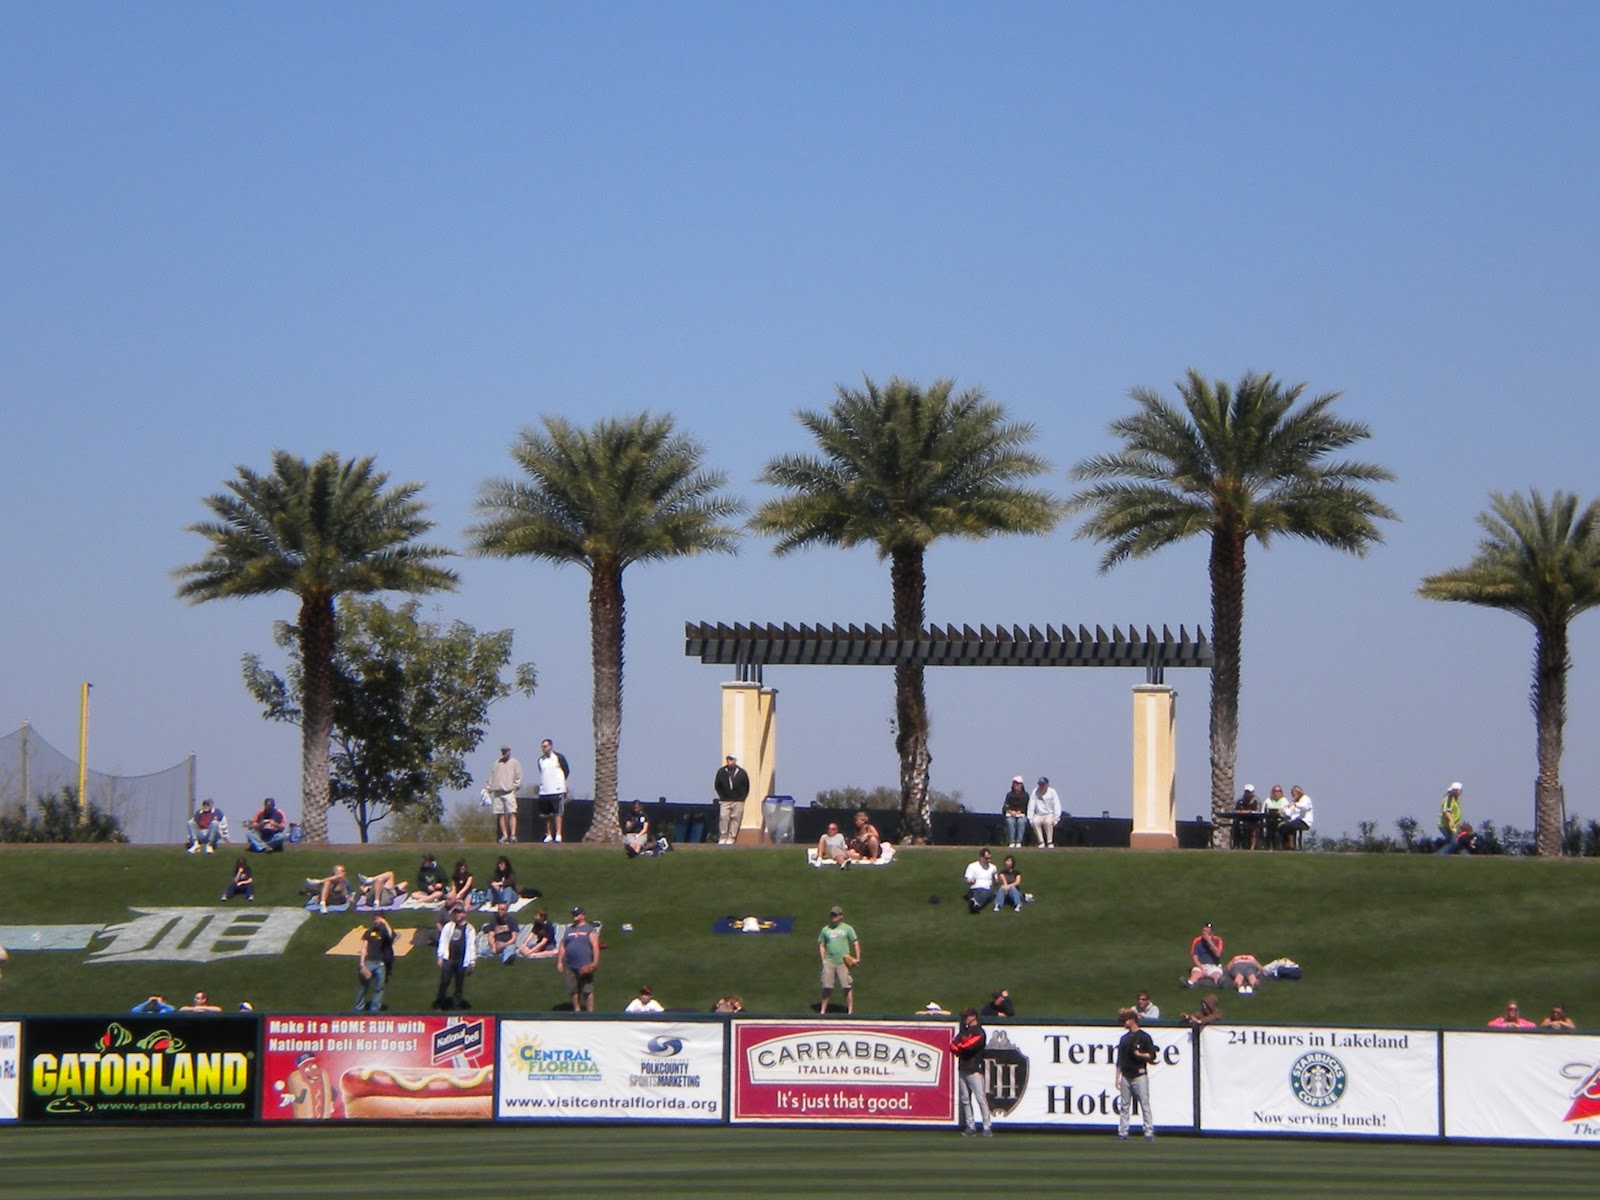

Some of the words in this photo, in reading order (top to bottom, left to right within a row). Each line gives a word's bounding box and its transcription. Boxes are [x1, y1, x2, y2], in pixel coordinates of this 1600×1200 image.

[270, 1021, 304, 1034] Make
[307, 1021, 317, 1034] it
[320, 1023, 328, 1034] a
[332, 1021, 366, 1034] HOME
[369, 1021, 395, 1034] RUN
[397, 1021, 425, 1034] with
[269, 1039, 324, 1051] National
[327, 1039, 352, 1051] Deli
[356, 1039, 377, 1051] Hot
[381, 1039, 418, 1052] Dogs!
[437, 1028, 465, 1048] National
[465, 1030, 480, 1045] Deli
[1228, 1030, 1247, 1044] 24
[1253, 1031, 1304, 1046] Hours
[1309, 1032, 1325, 1047] in
[1331, 1033, 1409, 1049] Lakeland
[520, 1046, 592, 1061] CENTRAL
[758, 1041, 932, 1072] CARRABBA'S
[1044, 1035, 1180, 1065] Terrce
[529, 1061, 600, 1073] FLORIDA
[798, 1066, 848, 1075] ITALIAN
[853, 1066, 890, 1075] GRILL
[1293, 1053, 1344, 1078] STARBUCKS
[32, 1053, 248, 1096] GATORLAND
[97, 1101, 245, 1111] www.gatorland.com
[505, 1096, 718, 1112] www.visitcentralflorida.org
[777, 1091, 799, 1108] It's
[801, 1093, 830, 1112] just
[833, 1091, 865, 1109] that
[868, 1092, 912, 1113] good.
[1299, 1091, 1338, 1106] COFFEE
[1253, 1111, 1282, 1124] Now
[1287, 1113, 1338, 1127] serving
[1342, 1114, 1386, 1126] lunch!
